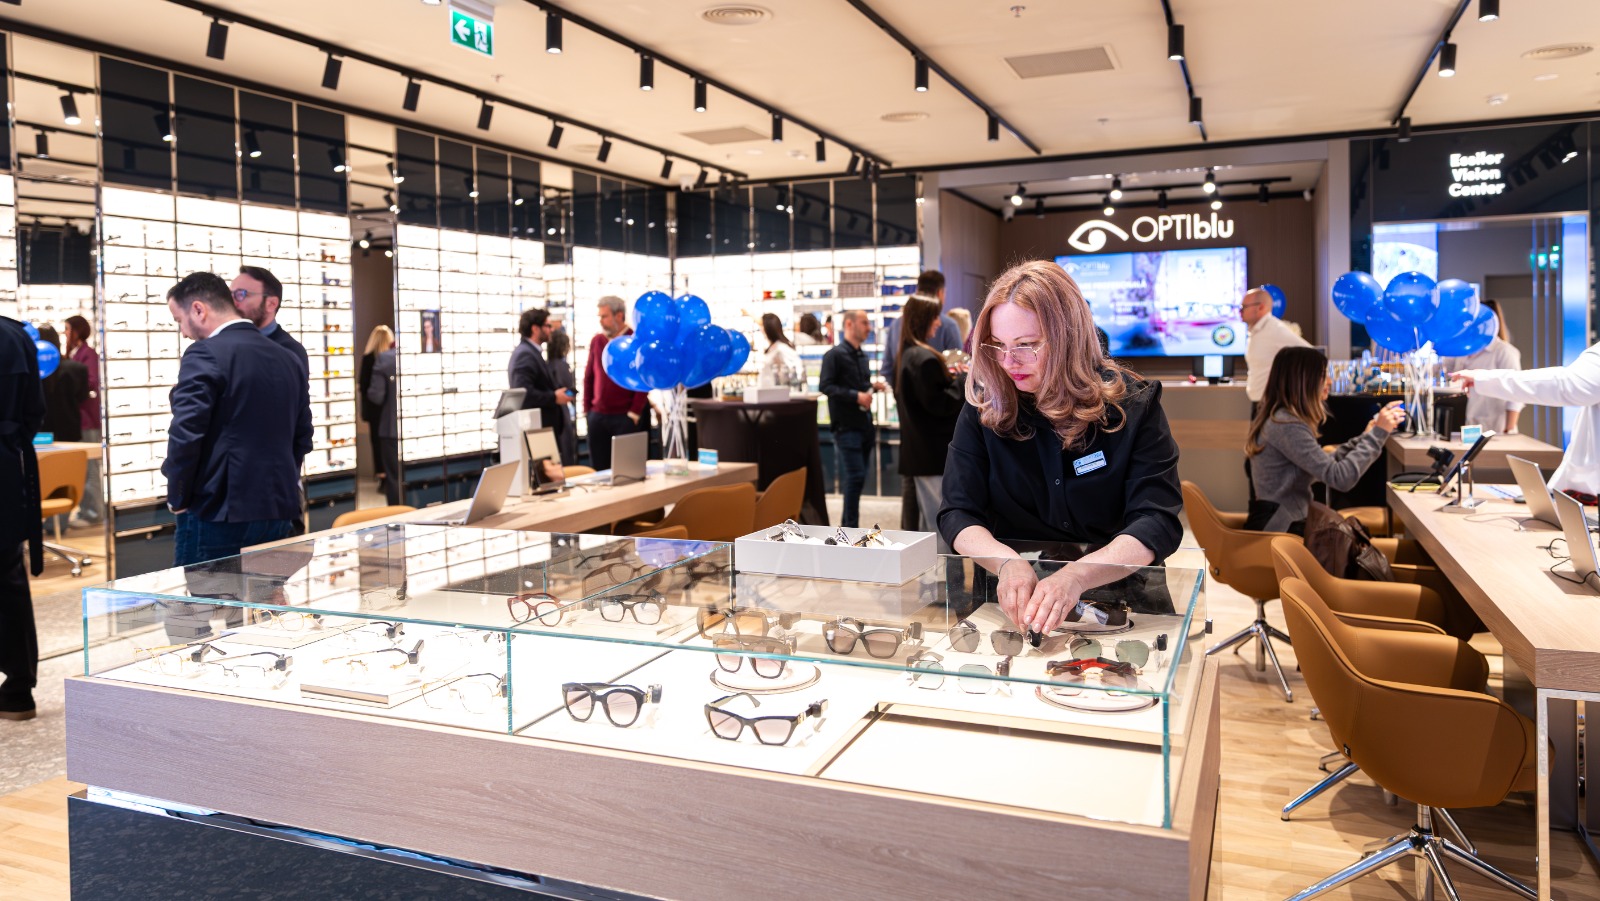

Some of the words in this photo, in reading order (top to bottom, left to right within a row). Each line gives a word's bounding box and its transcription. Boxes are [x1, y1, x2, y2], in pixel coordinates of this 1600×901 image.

[1449, 151, 1505, 168] Essilor
[1451, 167, 1502, 182] Vision
[1448, 182, 1506, 197] Center
[1131, 212, 1235, 243] OPTIblu
